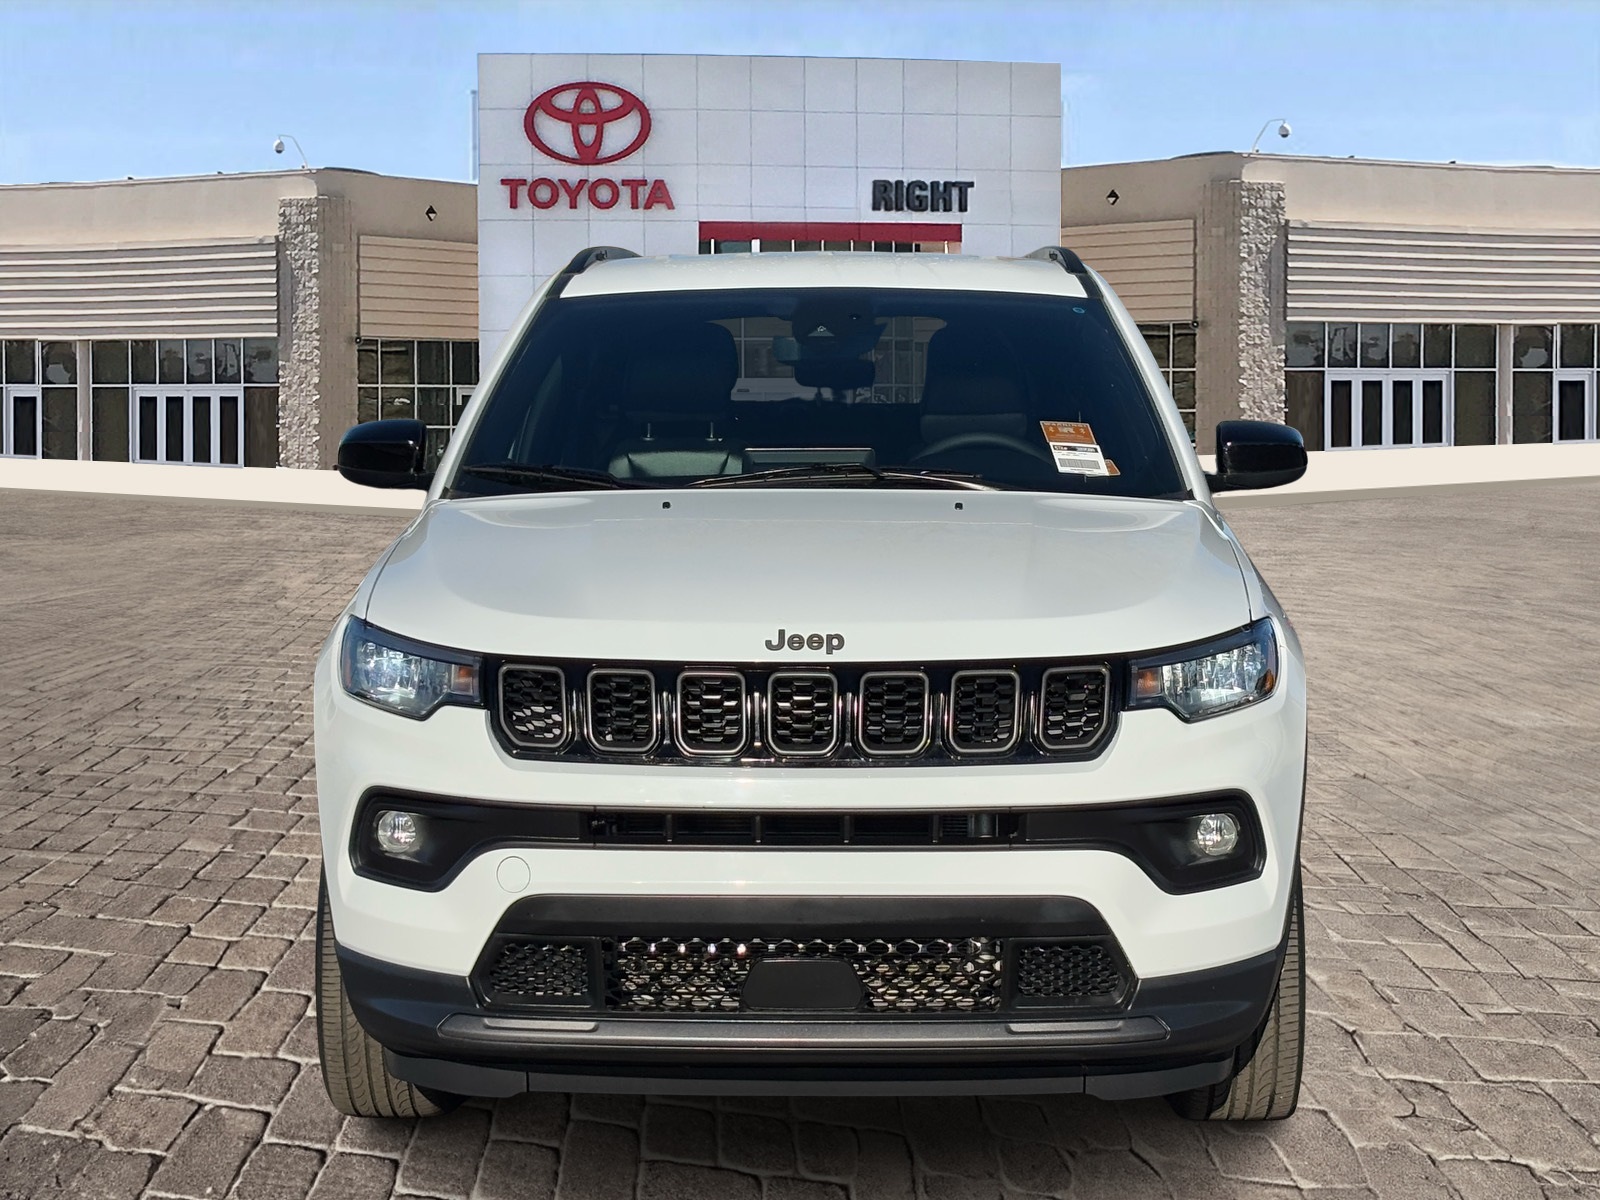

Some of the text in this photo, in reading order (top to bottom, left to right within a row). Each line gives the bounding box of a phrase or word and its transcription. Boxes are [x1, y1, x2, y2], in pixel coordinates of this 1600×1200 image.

[501, 179, 674, 210] TOYOTA
[871, 180, 975, 213] RIGHT
[765, 628, 845, 655] Jeep
